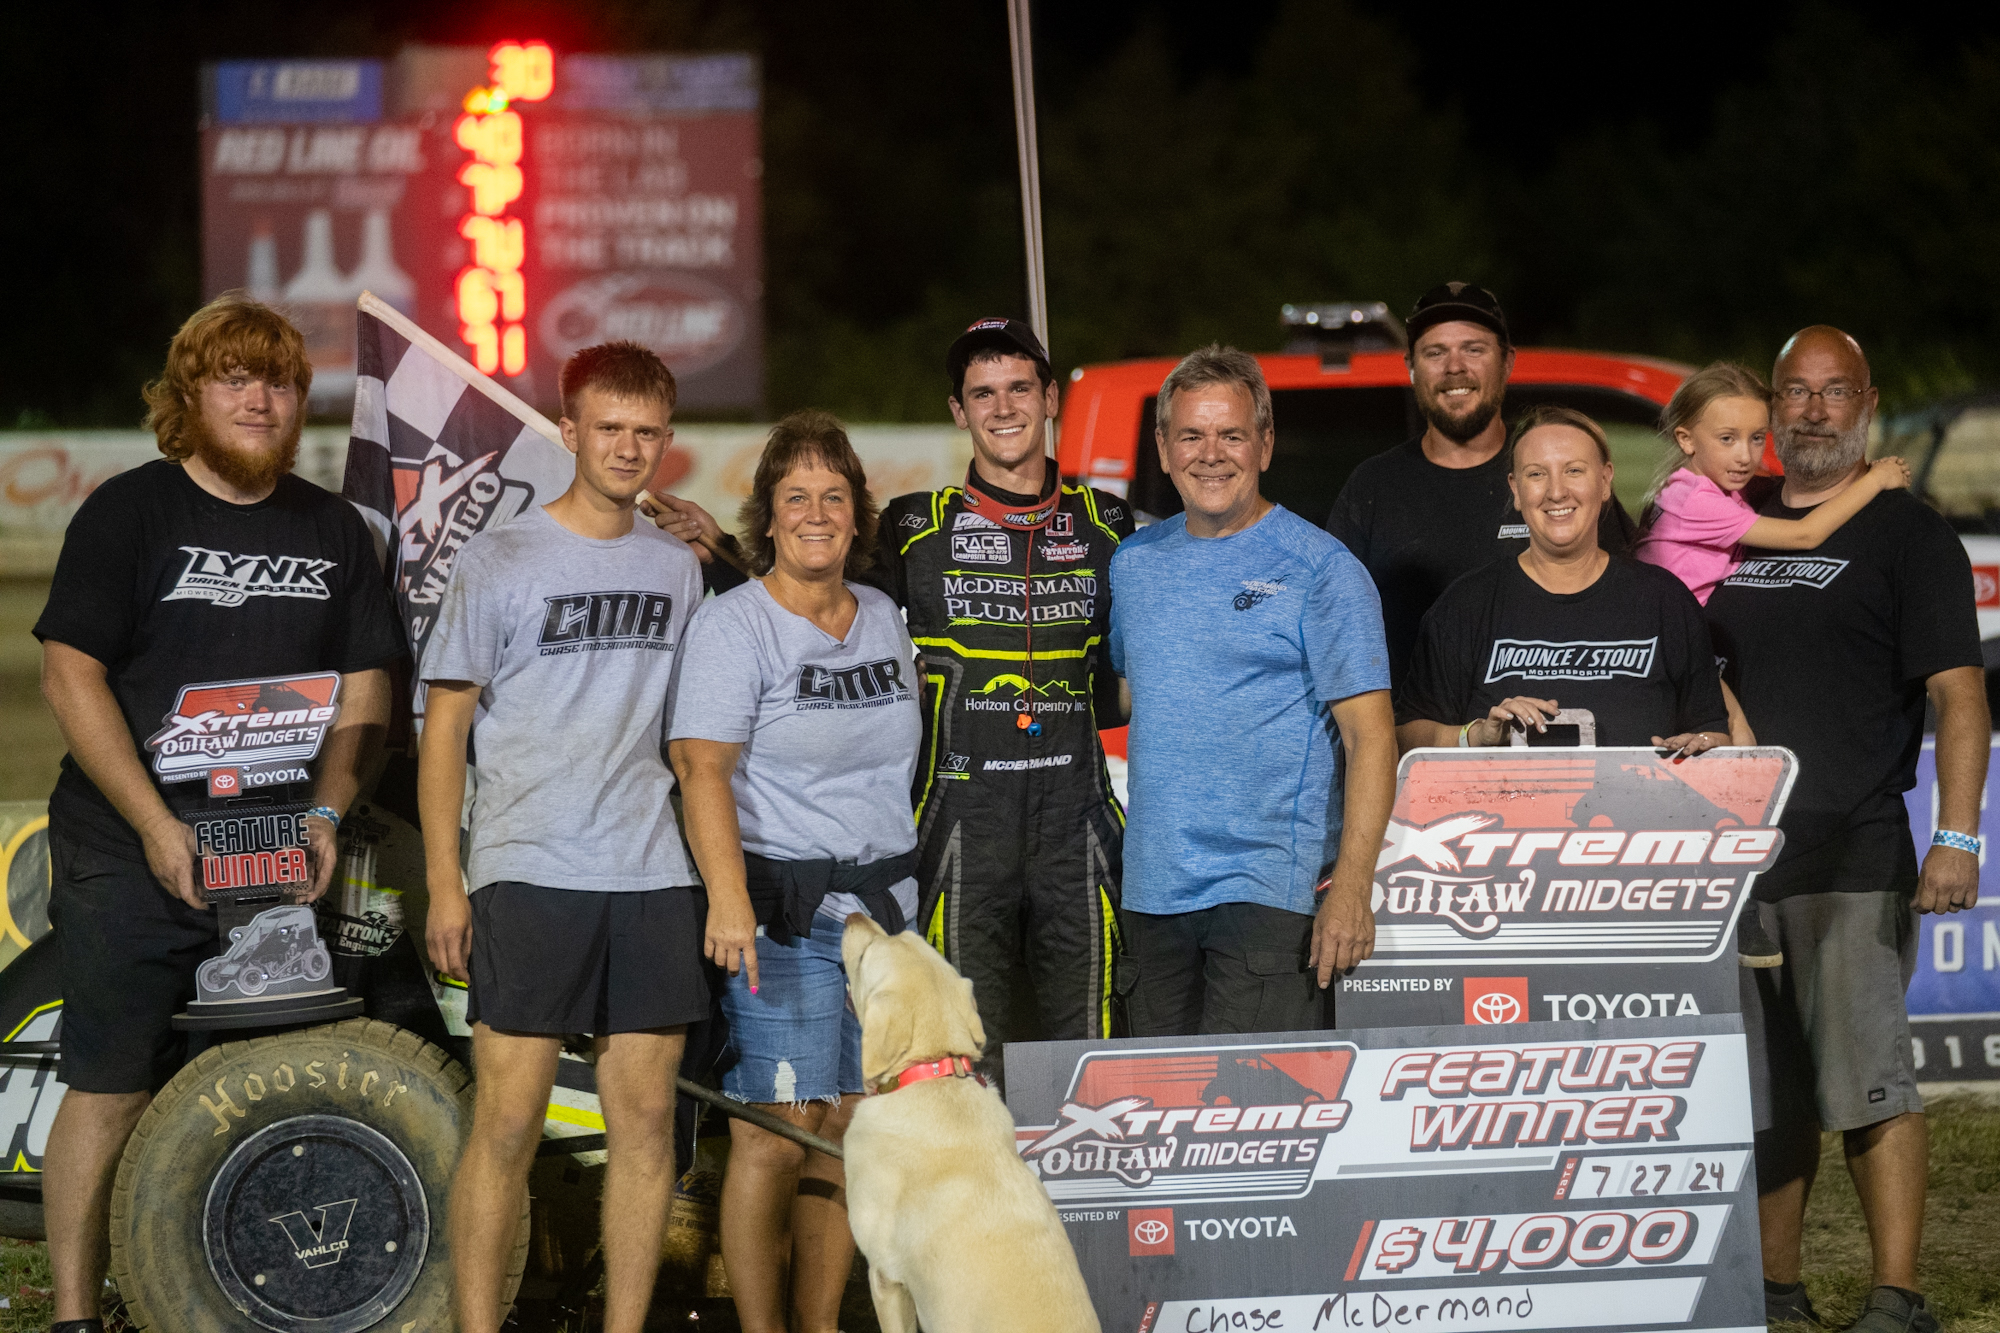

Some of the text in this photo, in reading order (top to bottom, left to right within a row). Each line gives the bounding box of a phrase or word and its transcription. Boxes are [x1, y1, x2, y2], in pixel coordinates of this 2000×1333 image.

[955, 535, 1007, 552] RACE
[187, 548, 338, 587] LYNK
[1780, 562, 1838, 581] STOUT
[185, 576, 240, 588] DRIVEN
[252, 586, 319, 594] CHASSIS
[1729, 576, 1791, 585] MOTORSPORTS
[537, 590, 673, 647] CMR
[944, 597, 1095, 622] PLUMBING
[540, 643, 579, 656] CHASE
[645, 641, 675, 652] RACING
[1495, 647, 1577, 673] MOUNCE
[1588, 648, 1650, 670] STOUT
[794, 656, 909, 703] CMR
[796, 702, 835, 711] CHASE
[965, 698, 1010, 712] Horizon
[1013, 698, 1073, 714] Carpentry
[241, 727, 320, 747] MIDGETS
[983, 754, 1073, 770] MCDERMAND
[163, 772, 199, 782] PRESENTED
[243, 768, 309, 786] TOYOTA
[194, 812, 310, 855] FEATURE
[203, 849, 307, 891] WINNER
[1541, 877, 1736, 912] MIDGETS
[339, 936, 381, 956] Engines
[1343, 978, 1701, 1022] PRESENTED BY TOYOTA
[1380, 1042, 1704, 1101] FEATURE
[199, 1051, 407, 1137] Hoosier
[1410, 1095, 1687, 1152] WINNER
[1181, 1138, 1320, 1167] MIDGETS
[1107, 1210, 1121, 1220] BY
[1184, 1215, 1298, 1241] TOYOTA
[295, 1239, 349, 1260] VAHLCO
[1375, 1210, 1699, 1275] $4,000
[1143, 1306, 1155, 1321] TO
[1313, 1288, 1534, 1331] McDermand
